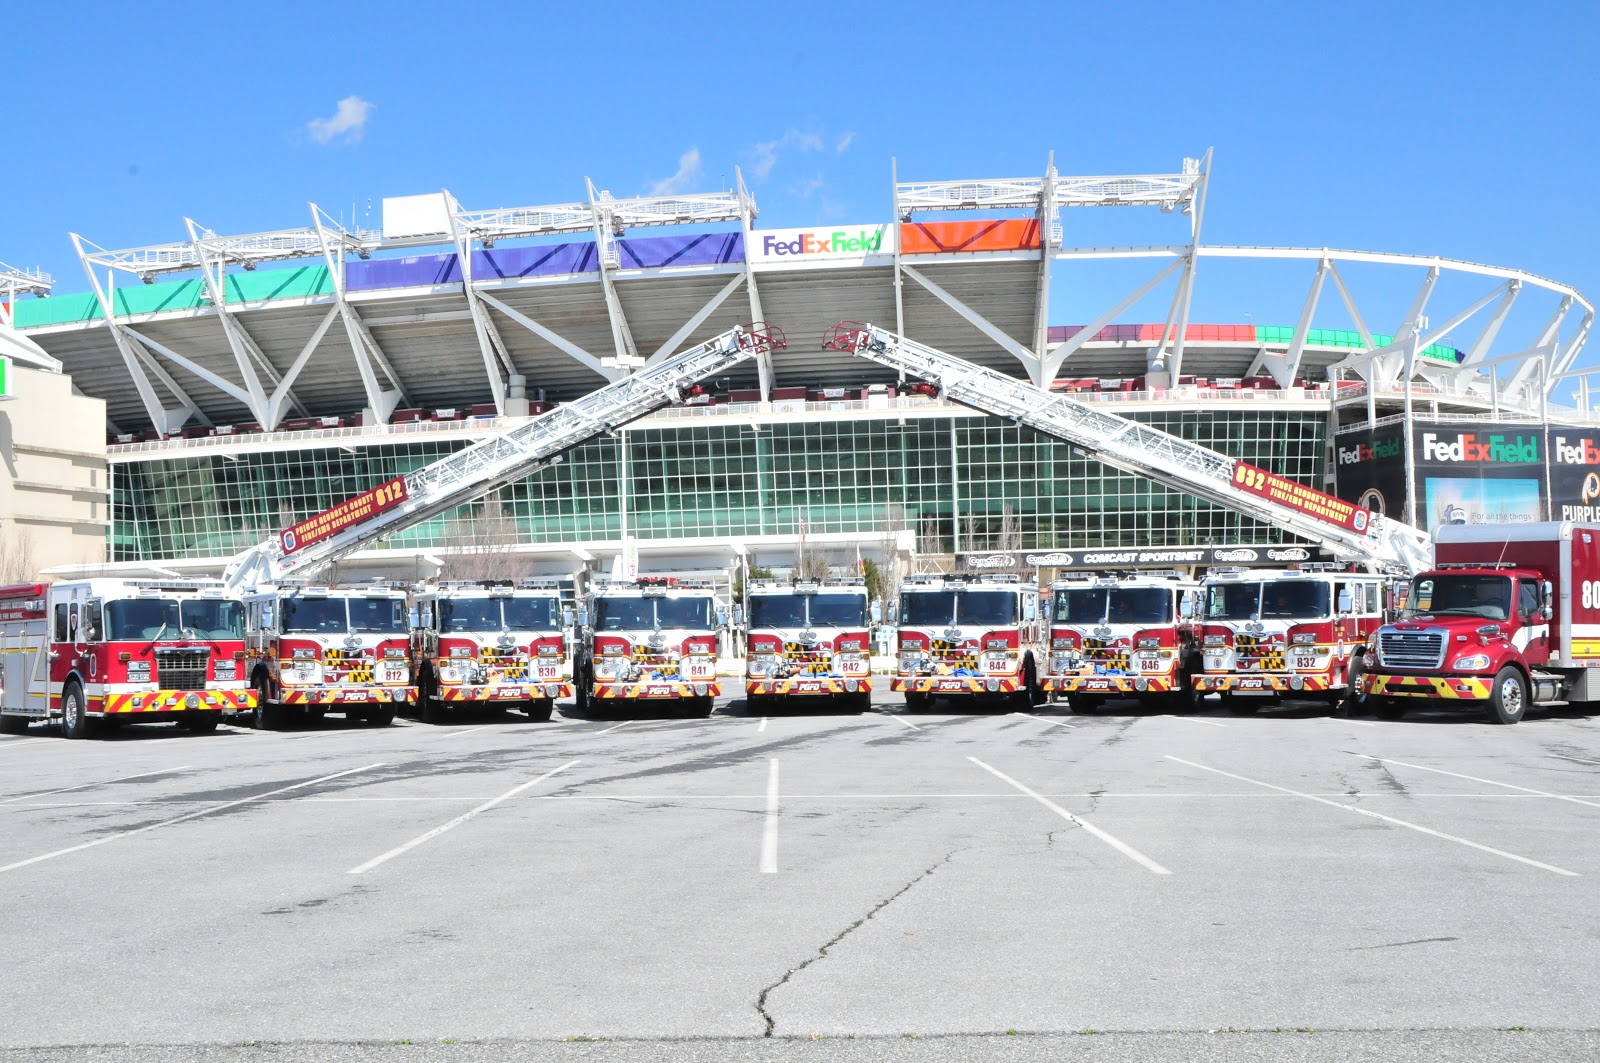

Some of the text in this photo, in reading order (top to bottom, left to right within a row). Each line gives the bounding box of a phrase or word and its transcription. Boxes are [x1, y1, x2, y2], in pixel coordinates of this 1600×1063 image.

[763, 229, 881, 256] FedExField
[1339, 436, 1399, 465] FedExField
[1423, 432, 1538, 463] FedExField
[1236, 466, 1354, 515] 832 PRINCE GEORGE'S COUNTY
[295, 481, 403, 536] PRINCE GEORGE'S COUNTY 812
[1270, 488, 1347, 523] FIRE/EMS DEPARTMENT
[1472, 512, 1484, 520] For
[1486, 512, 1494, 520] all
[1496, 512, 1507, 520] the
[1510, 512, 1531, 521] things
[1562, 505, 1600, 523] PURPLE
[301, 504, 372, 542] FIRE/EMS DEPARTMENT
[1083, 551, 1204, 563] COMCAST SPORTSNET
[842, 662, 860, 672] 842
[989, 661, 1006, 671] 844
[1141, 660, 1159, 670] 846
[1297, 657, 1316, 668] 832
[538, 667, 556, 677] 830
[691, 665, 706, 675] 841
[386, 671, 402, 680] 812
[940, 681, 961, 689] PGFD
[1241, 680, 1262, 688] PGFD
[344, 692, 367, 700] PGFD
[500, 688, 520, 696] PGFD
[649, 687, 670, 695] PGFD
